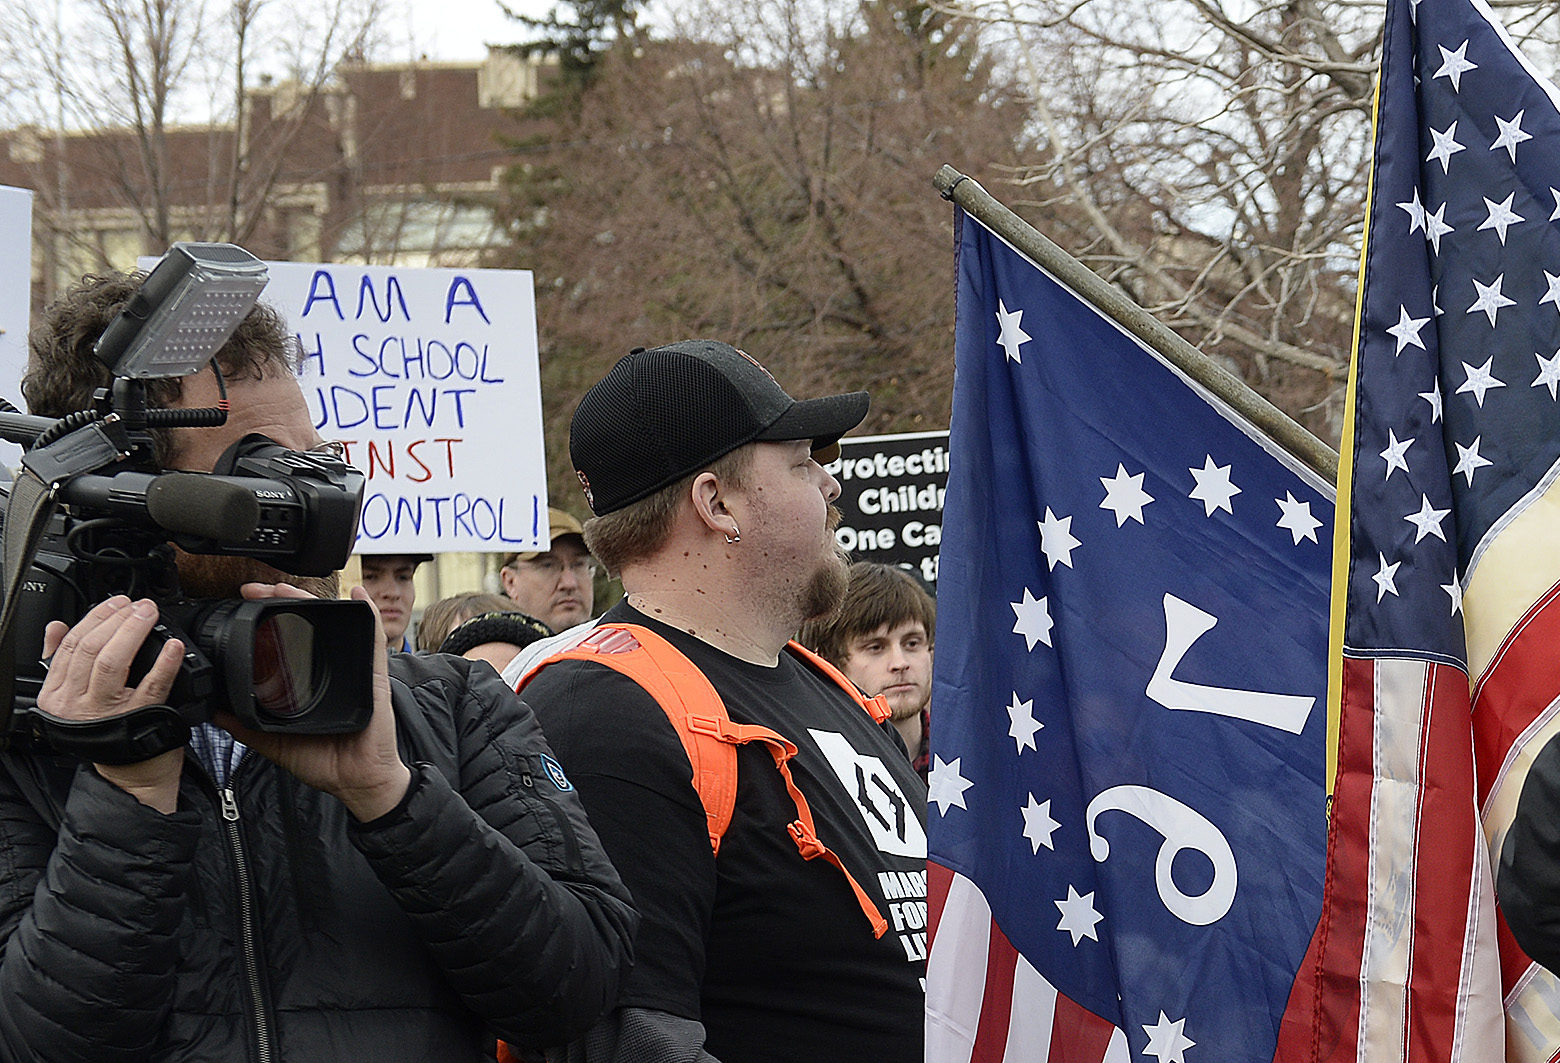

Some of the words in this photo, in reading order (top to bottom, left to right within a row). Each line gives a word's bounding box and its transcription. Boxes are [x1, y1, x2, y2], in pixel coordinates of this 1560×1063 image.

[301, 270, 411, 323] AM
[444, 275, 492, 326] A
[347, 333, 505, 383] SCHOOL
[255, 489, 286, 500] SONY
[354, 492, 539, 546] ONTROL!
[835, 526, 897, 552] One
